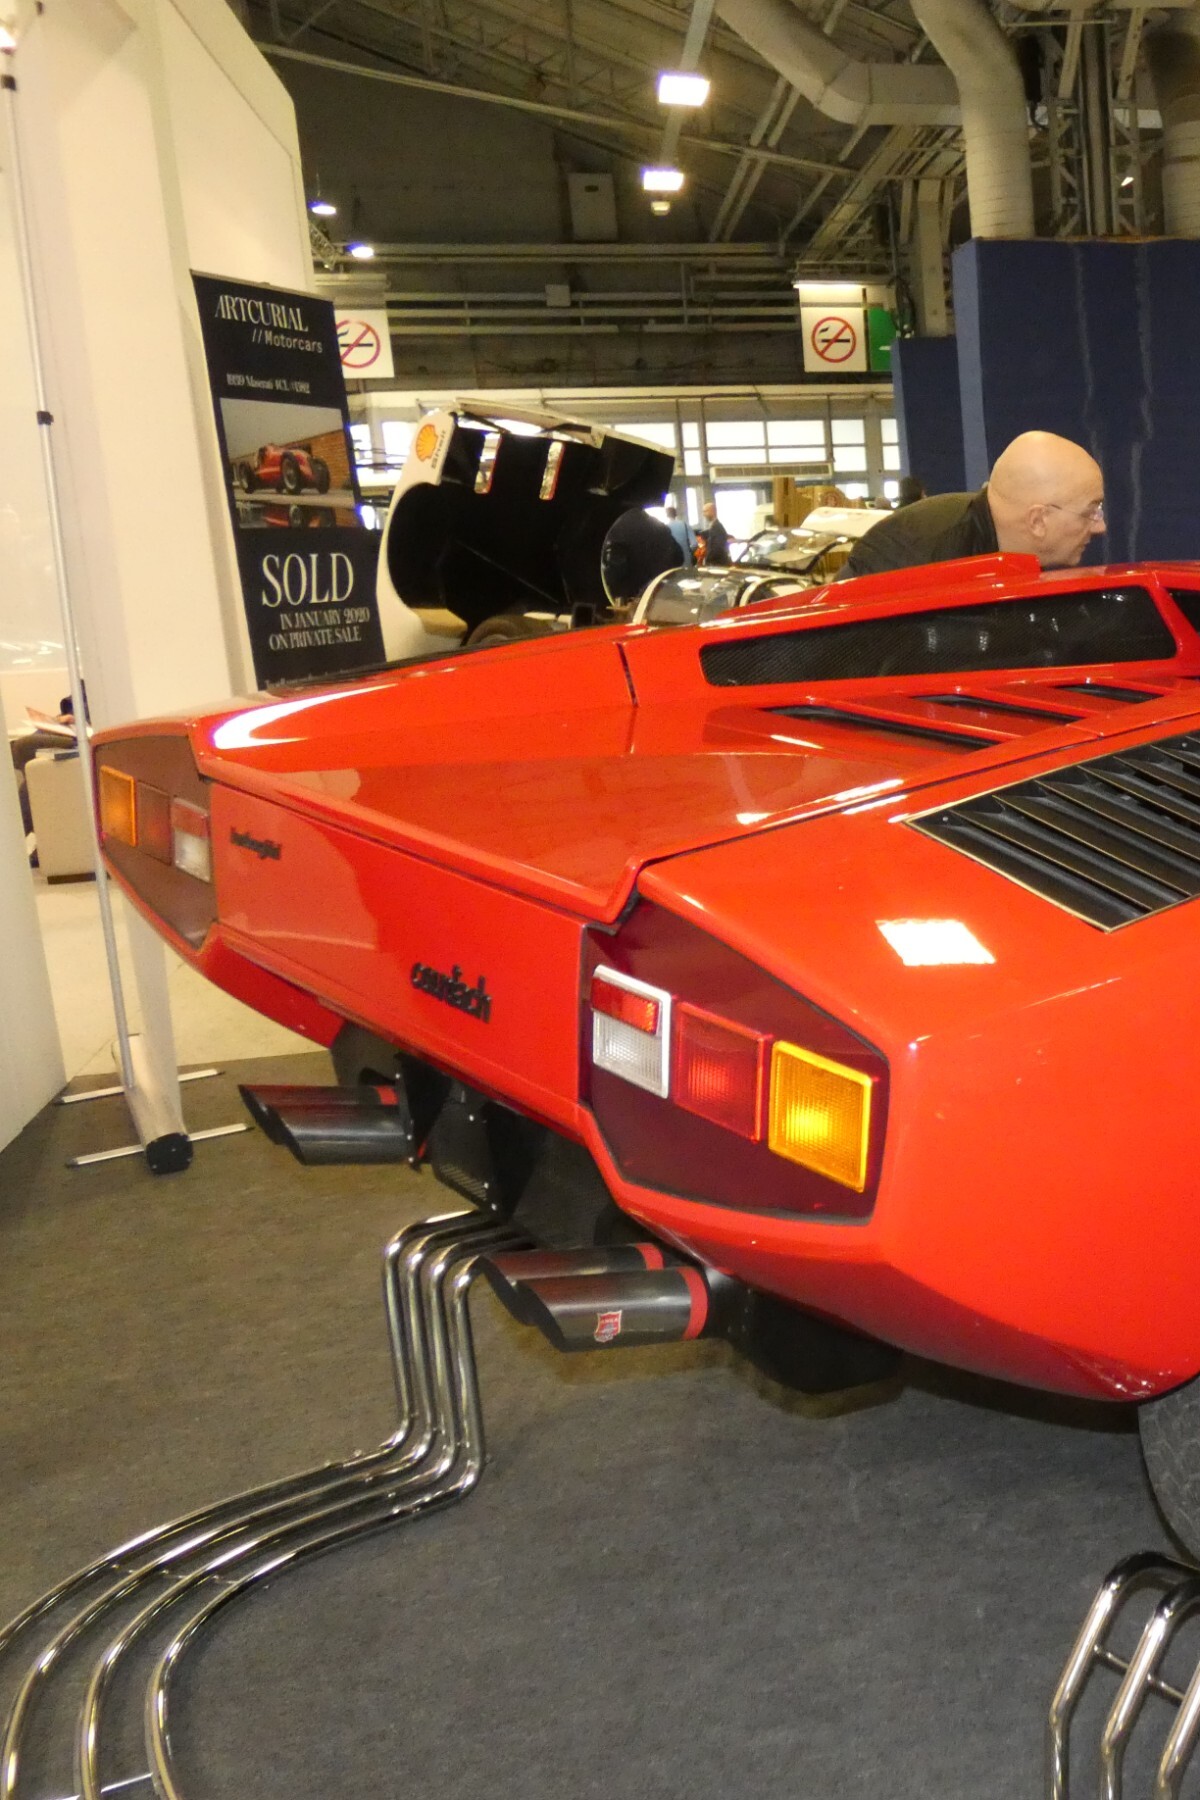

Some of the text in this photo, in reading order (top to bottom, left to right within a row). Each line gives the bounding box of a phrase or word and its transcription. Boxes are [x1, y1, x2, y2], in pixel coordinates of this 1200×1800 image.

[215, 295, 309, 332] ARTCURIAL
[262, 553, 354, 608] SOLD
[280, 607, 370, 631] IN JANUARY 2020
[269, 625, 361, 651] ON PRIVATE SALE
